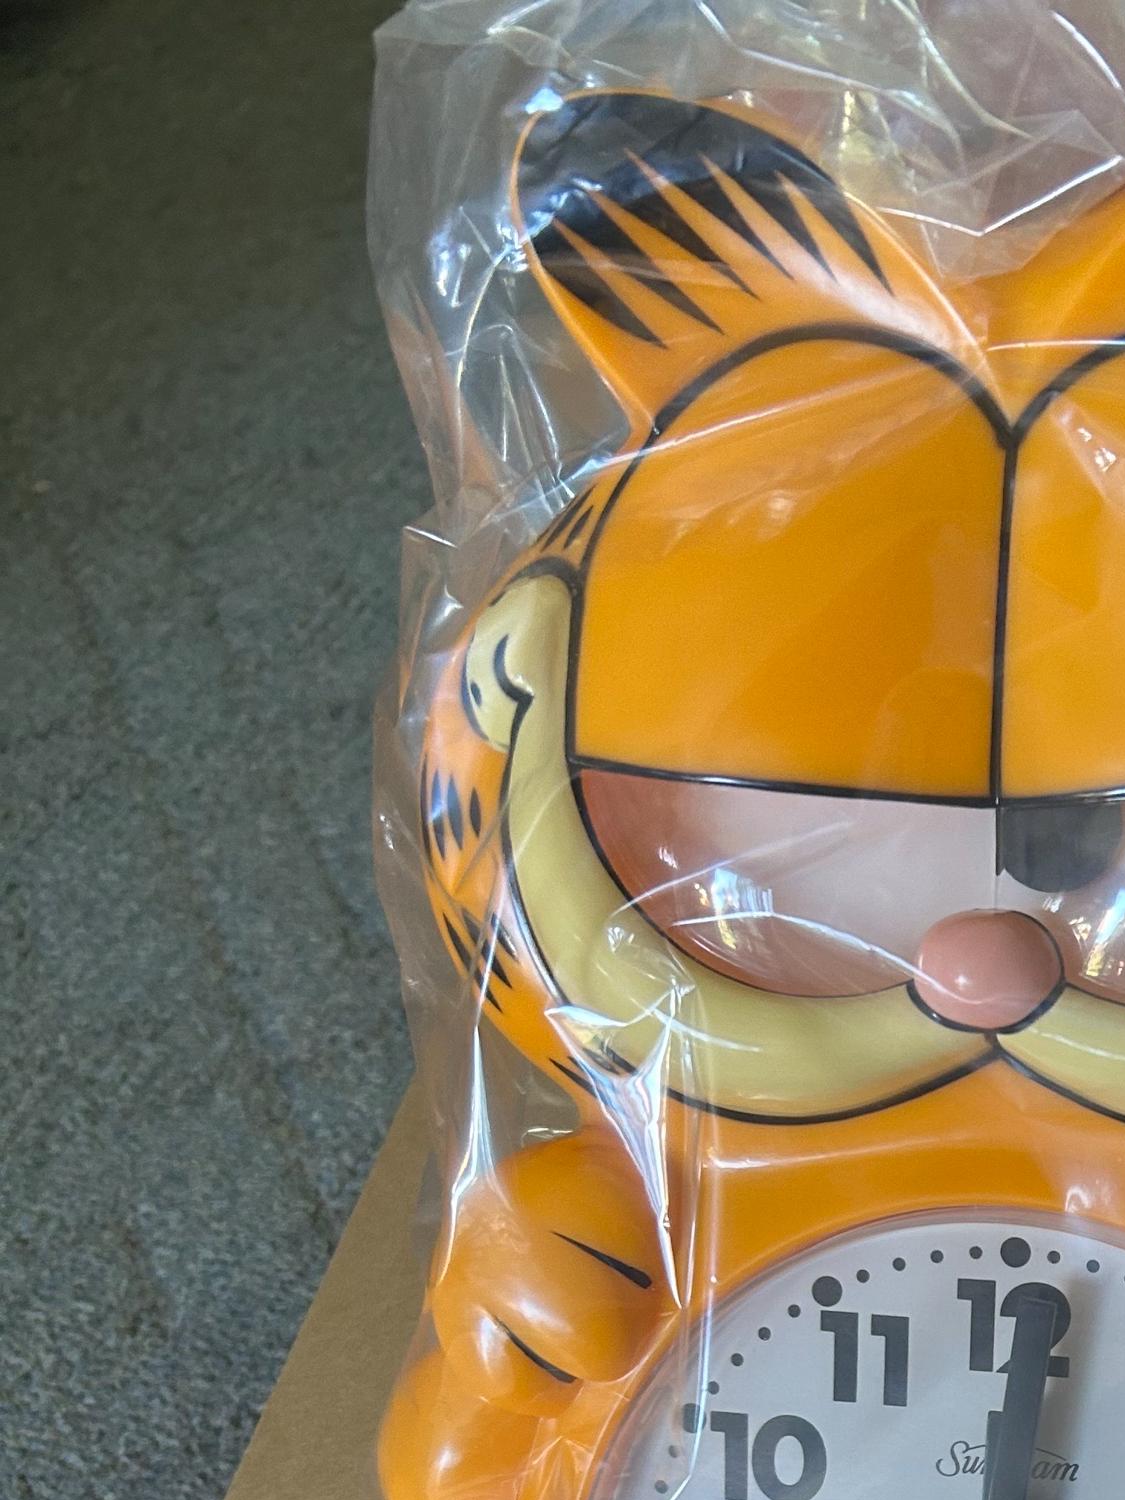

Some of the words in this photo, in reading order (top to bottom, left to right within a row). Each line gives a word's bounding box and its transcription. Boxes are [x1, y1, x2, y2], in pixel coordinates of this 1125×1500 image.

[820, 1310, 909, 1407] 11
[957, 1278, 1071, 1378] 12
[935, 1440, 1080, 1482] Suam
